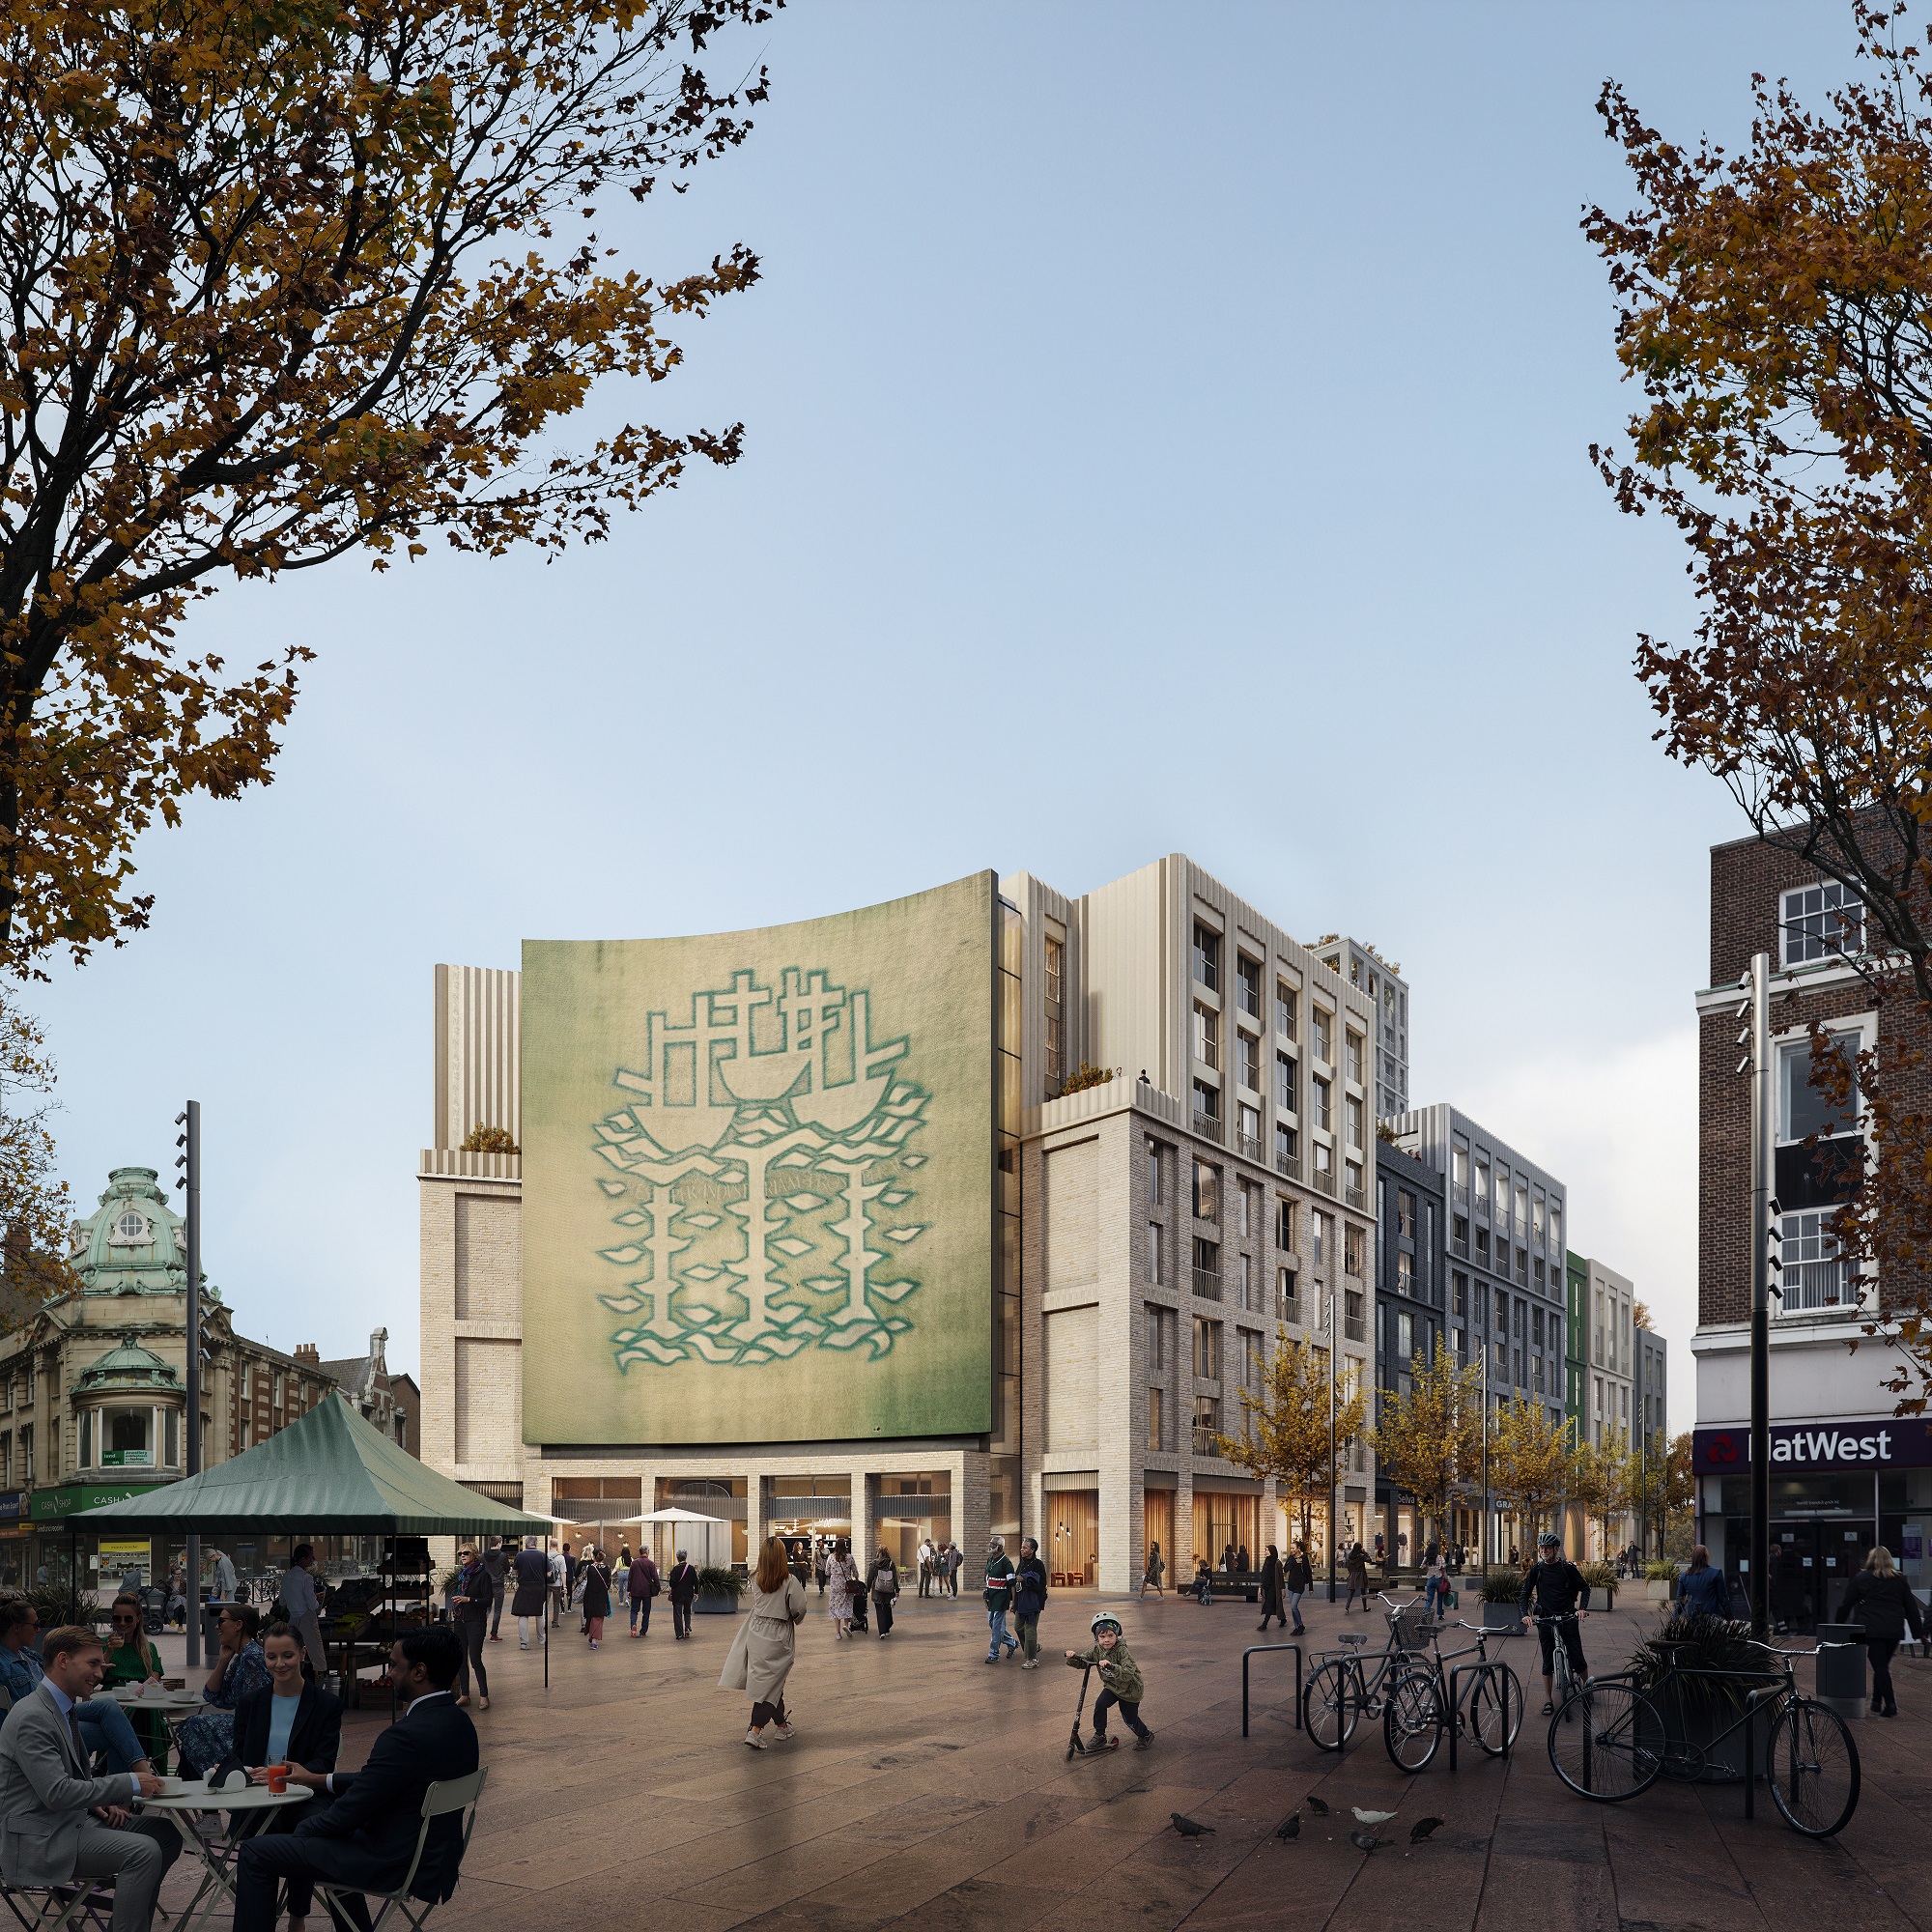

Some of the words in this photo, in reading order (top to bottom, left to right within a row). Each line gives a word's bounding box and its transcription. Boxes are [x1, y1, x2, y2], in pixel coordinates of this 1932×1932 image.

[1748, 1430, 1892, 1463] atWest
[41, 1500, 53, 1510] CASH
[58, 1498, 71, 1509] SHOP
[1397, 1493, 1415, 1504] Selva
